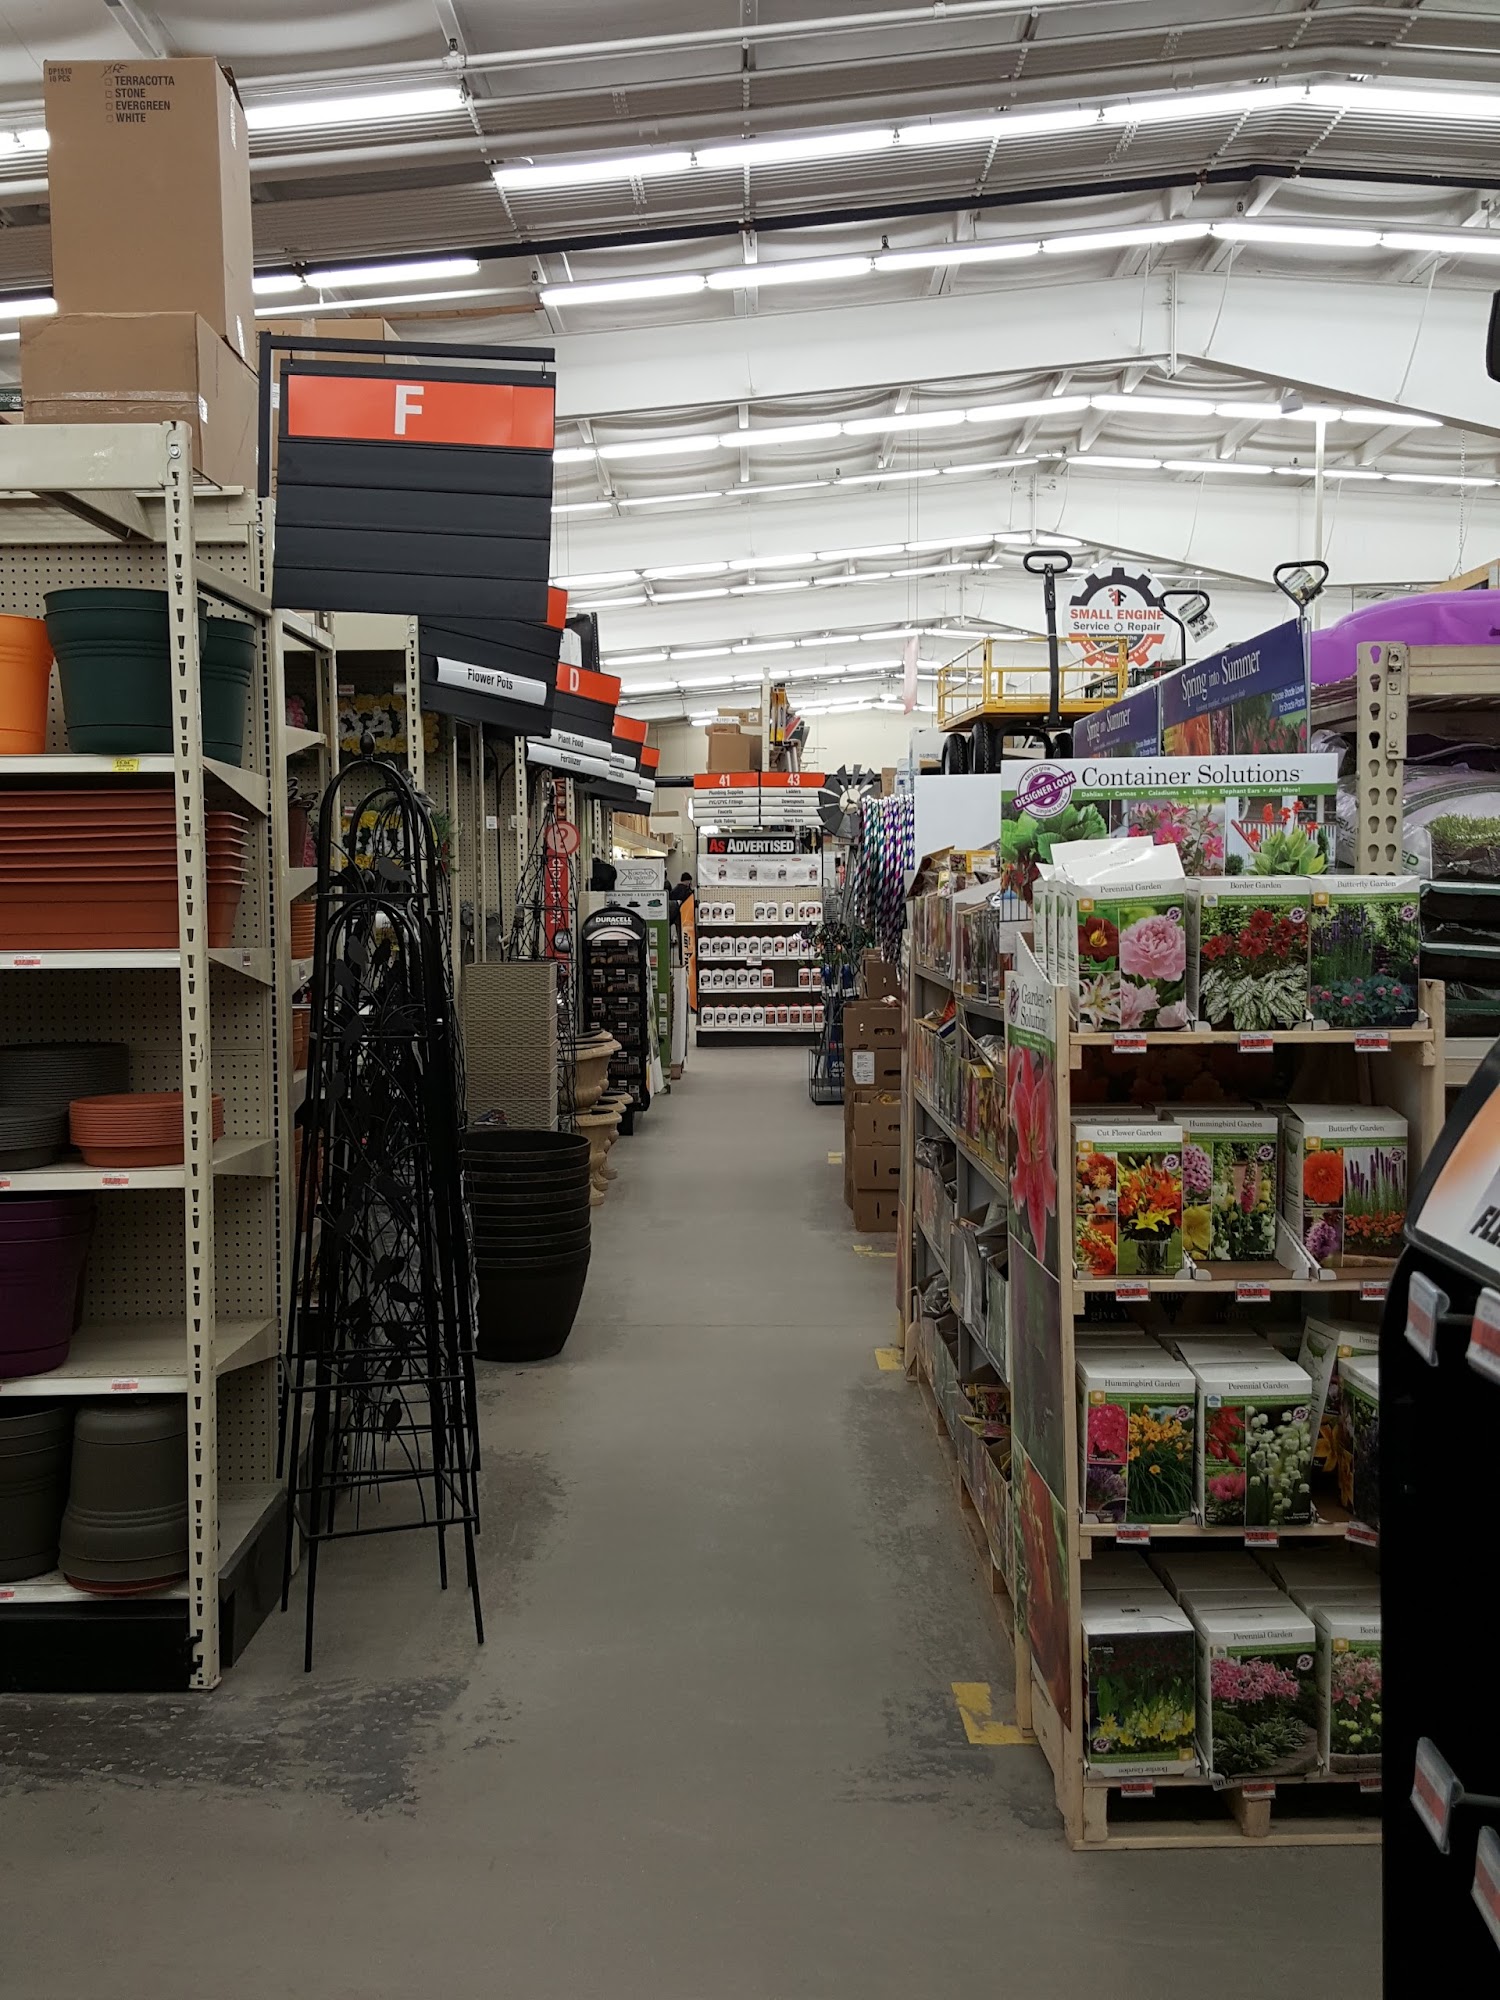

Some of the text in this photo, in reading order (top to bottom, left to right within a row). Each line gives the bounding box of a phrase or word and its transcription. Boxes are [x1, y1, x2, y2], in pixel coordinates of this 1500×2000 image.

[58, 74, 71, 82] PCS
[115, 75, 175, 86] TERRACOTTA
[115, 87, 146, 98] STONE
[116, 100, 170, 110] EVERGREEN
[116, 112, 146, 123] WHITE
[393, 384, 425, 435] F
[1070, 608, 1165, 620] SMALL ENGINE
[1073, 621, 1161, 633] Service Repair
[467, 667, 514, 691] Flower Pots
[569, 668, 580, 692] D
[1181, 670, 1207, 707] Spring
[1208, 669, 1220, 688] into
[1221, 649, 1260, 685] Summer
[1086, 717, 1100, 748] Spring
[1106, 707, 1130, 732] Summer
[558, 733, 584, 749] Plant Food
[560, 752, 582, 767] Fertilizer
[719, 774, 731, 787] 41
[787, 773, 800, 786] 43
[1082, 763, 1300, 787] Container Solutions
[1015, 772, 1075, 808] DESIGNER LOOK
[1081, 790, 1104, 798] Dahlias
[1148, 789, 1180, 797] Caladiums
[1192, 788, 1208, 796] Lilies
[1219, 787, 1247, 796] Elephant
[1269, 786, 1281, 794] And
[1100, 882, 1162, 894] Perennial Garden
[1230, 881, 1281, 889] Border Garden
[1337, 879, 1396, 889] Butterfly Garden
[1022, 984, 1044, 1009] Garden
[1189, 1120, 1262, 1128] Hummingbird Garden
[1328, 1123, 1385, 1134] Butterfly Garden
[1097, 1128, 1162, 1137] Cut Flower Garden
[1104, 1378, 1180, 1389] Hummingbird Garden
[1228, 1381, 1289, 1390] Perennial Garden
[1233, 1629, 1293, 1641] Perennial Garden
[1360, 1626, 1381, 1635] Borde
[1118, 1765, 1168, 1775] Border Garden
